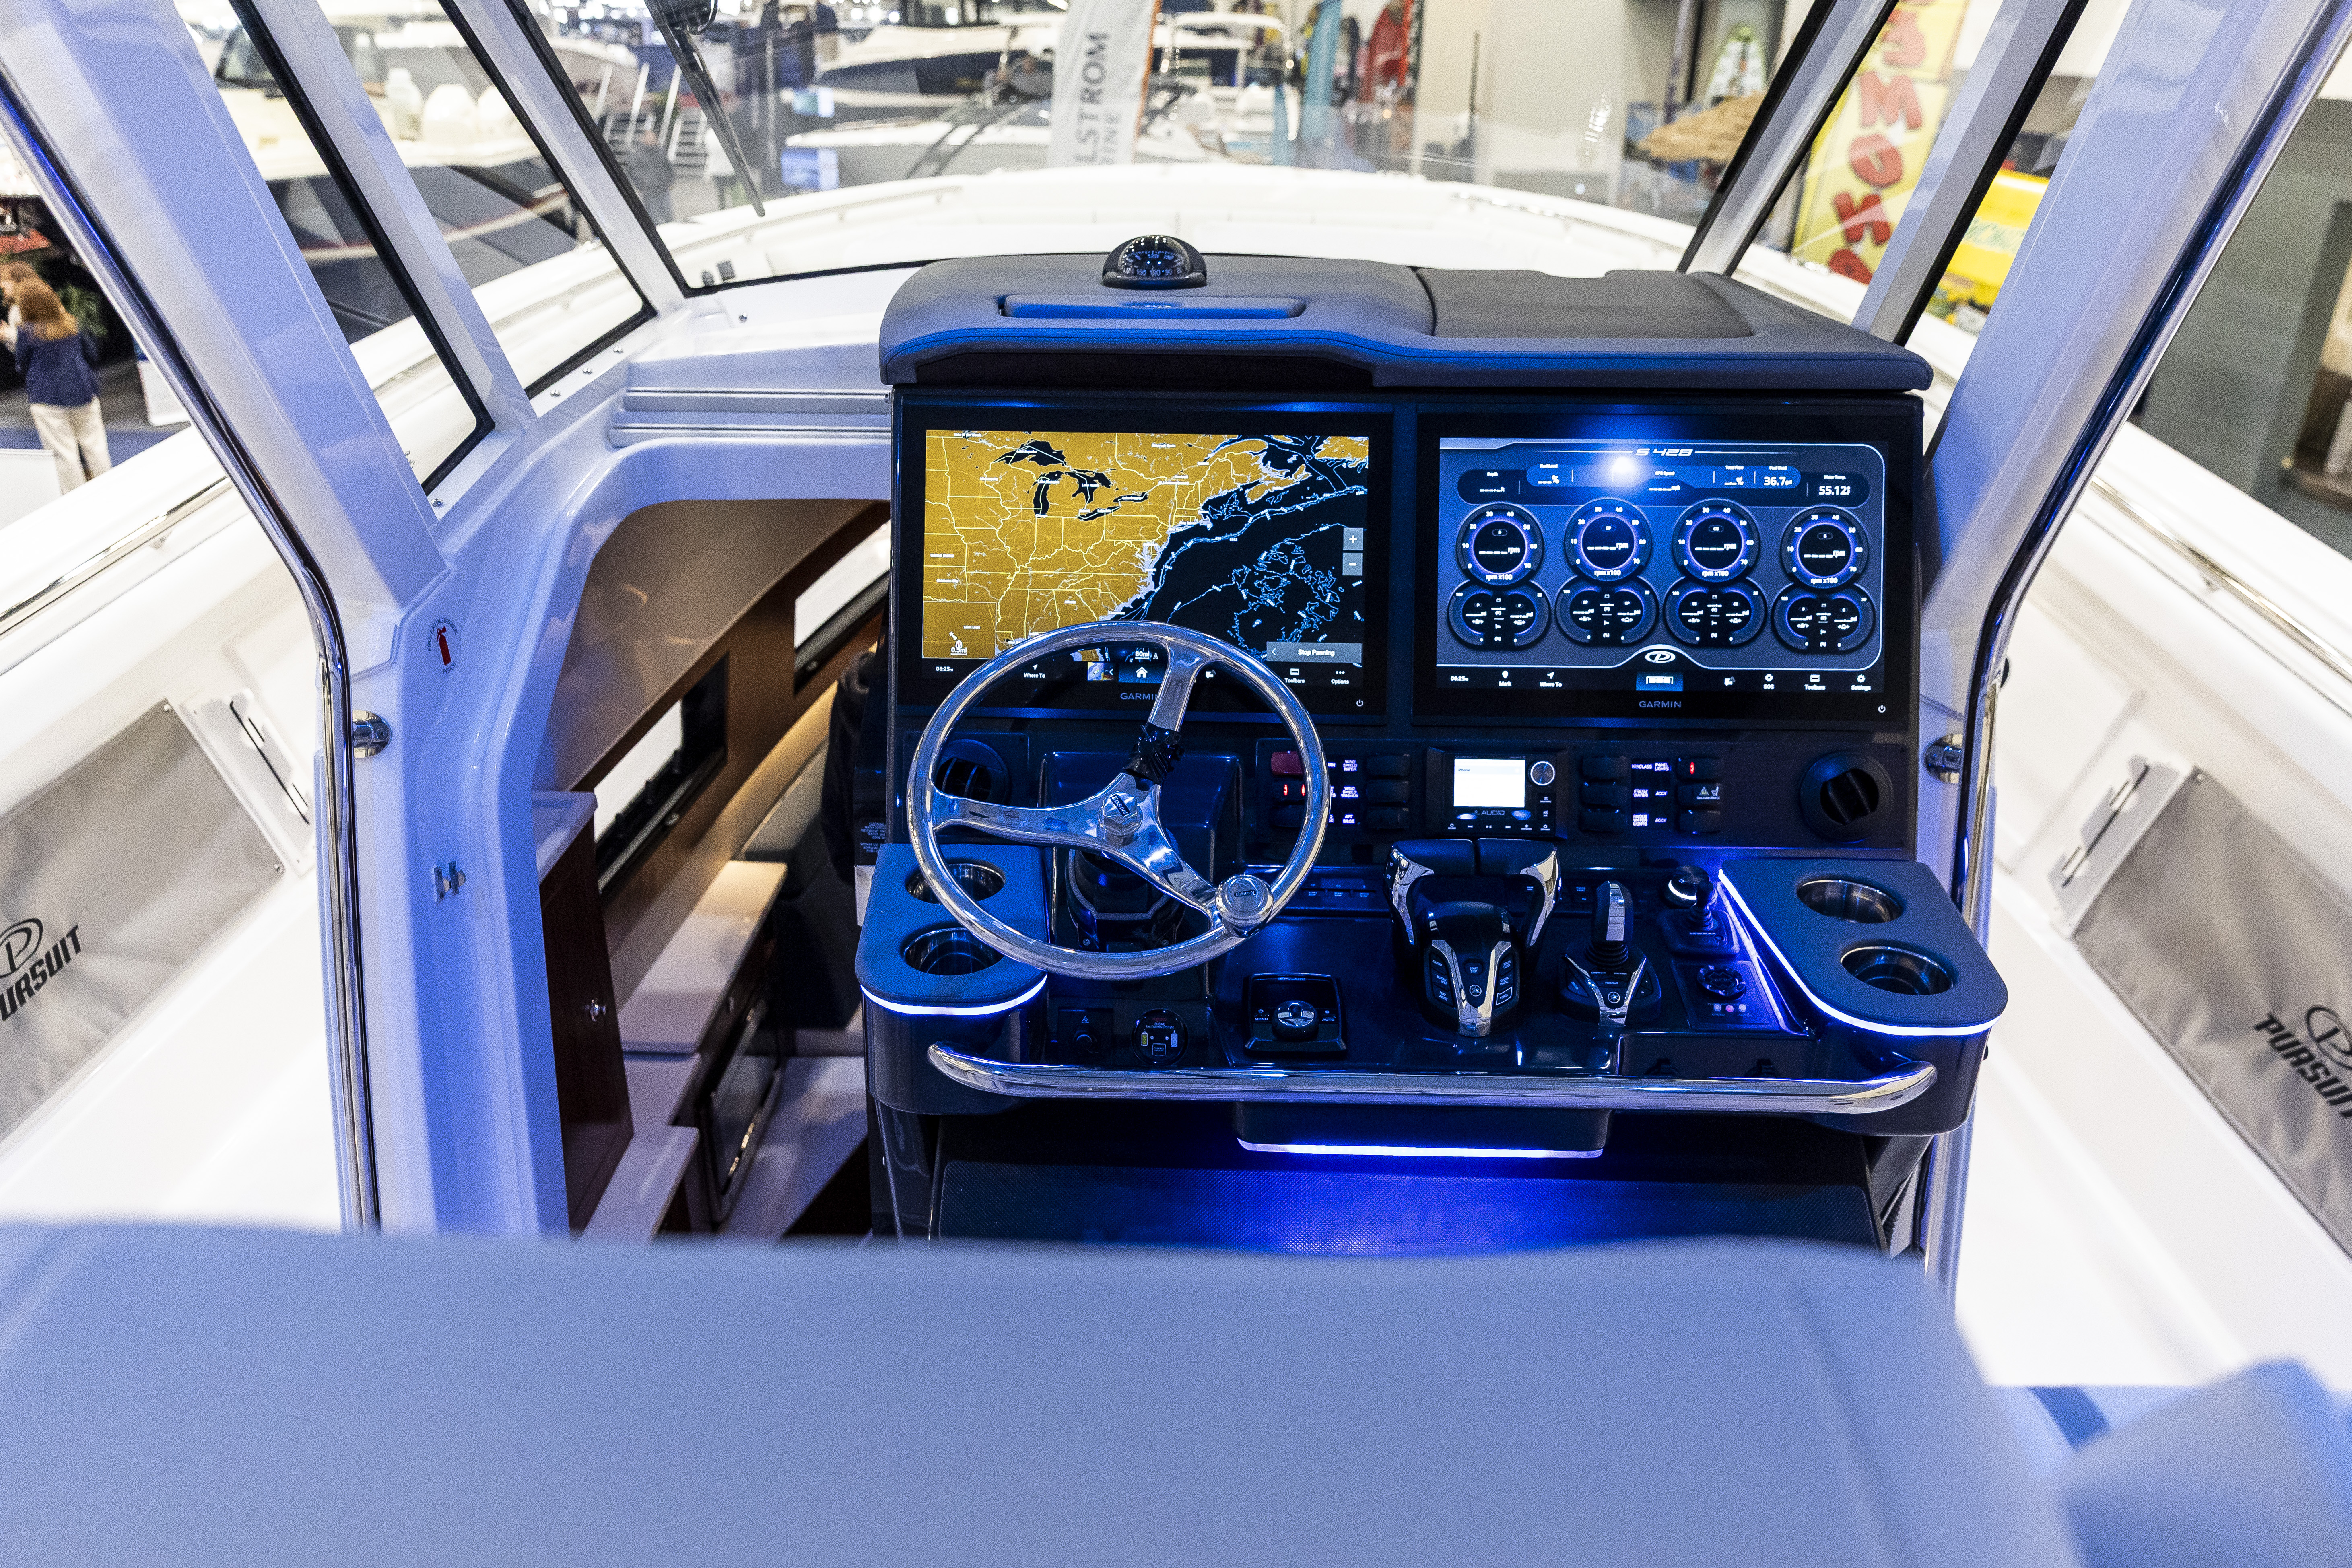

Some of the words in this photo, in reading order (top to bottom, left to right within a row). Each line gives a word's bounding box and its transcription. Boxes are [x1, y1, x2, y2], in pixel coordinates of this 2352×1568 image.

[430, 617, 458, 635] EXTINGUISHER
[443, 661, 456, 674] INSIDE
[1111, 796, 1128, 815] EDSON
